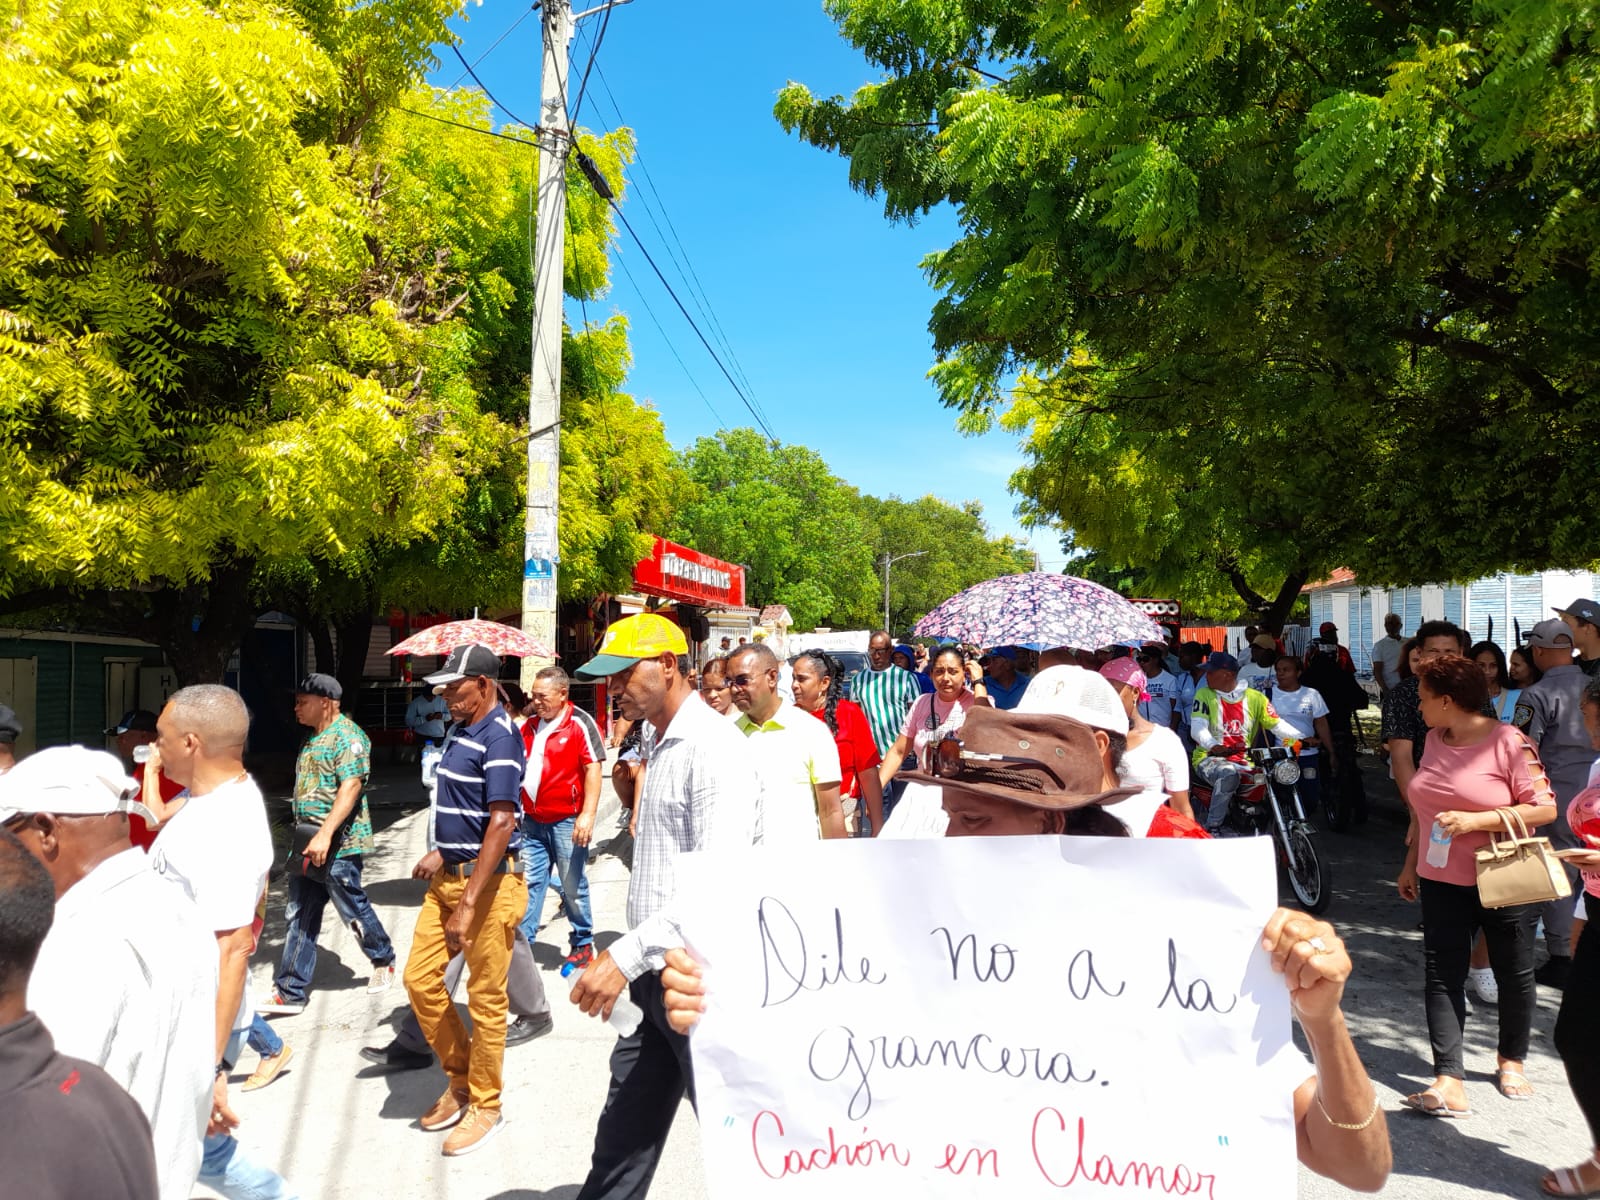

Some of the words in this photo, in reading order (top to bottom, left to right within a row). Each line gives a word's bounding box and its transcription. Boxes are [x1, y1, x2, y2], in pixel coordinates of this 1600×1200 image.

[758, 896, 887, 1008] Dile
[1068, 949, 1126, 1000] a
[1157, 937, 1238, 1014] la
[808, 1025, 1110, 1121] grancera.
[935, 1143, 1000, 1177] en
